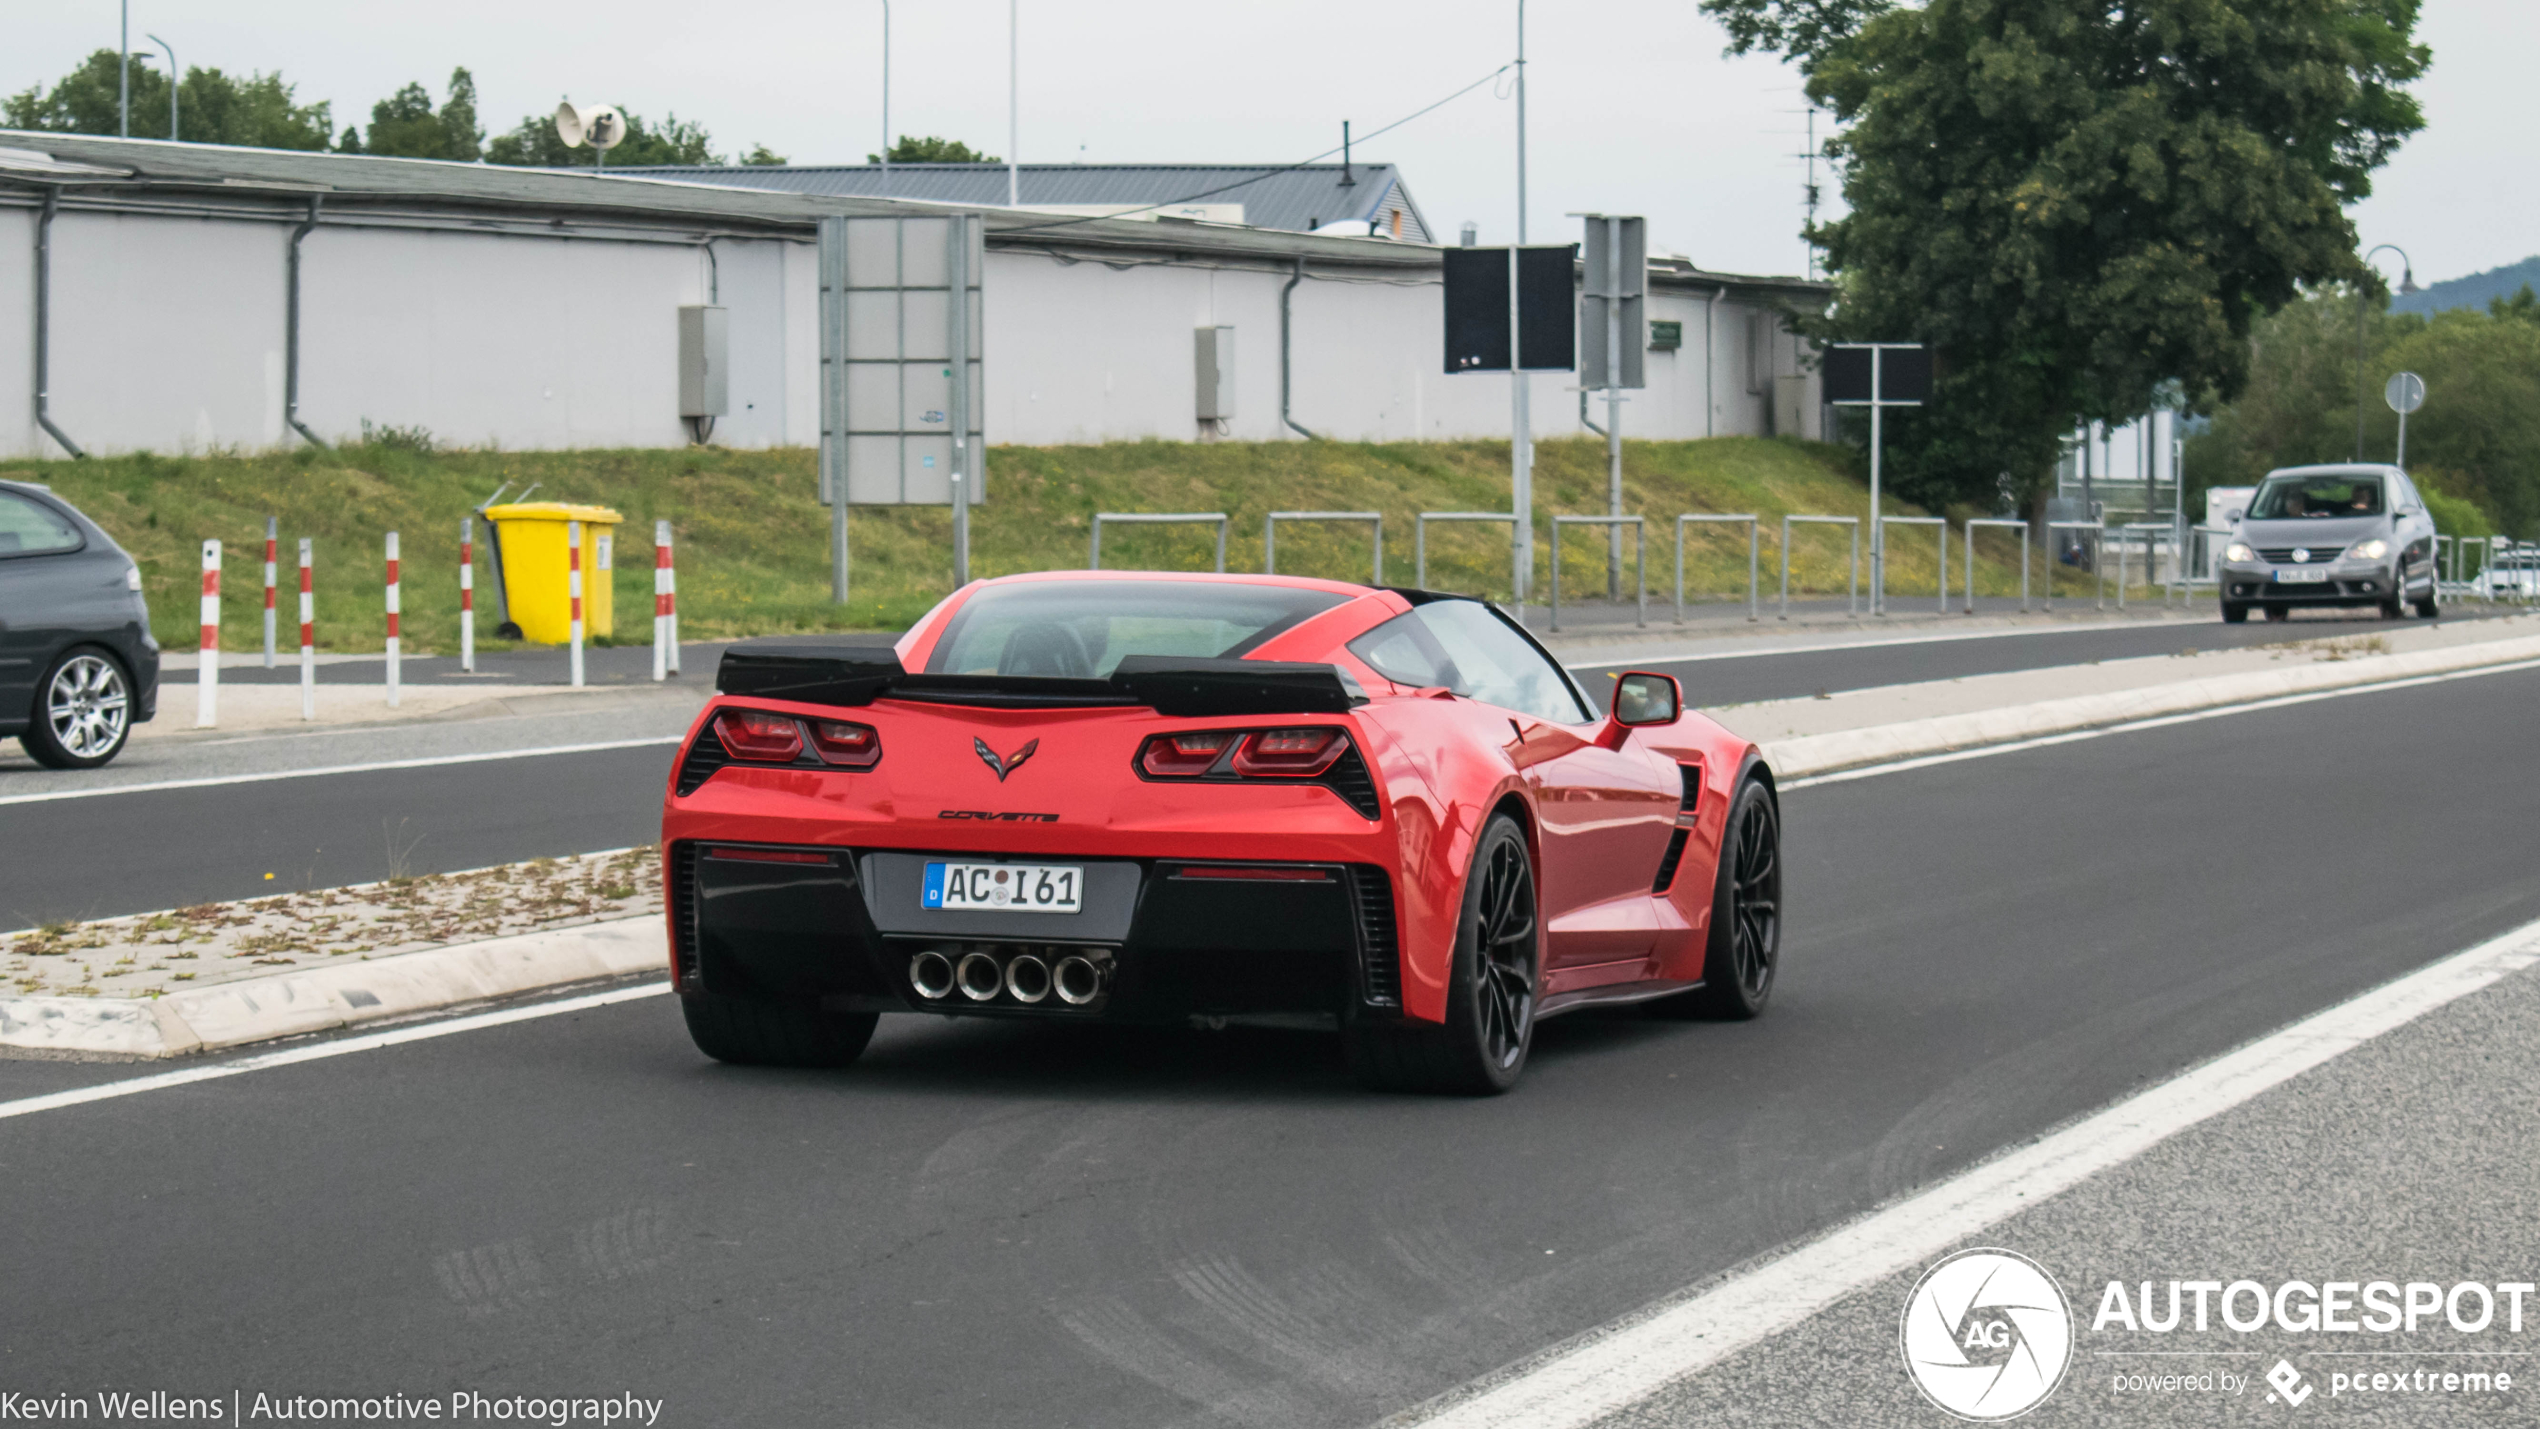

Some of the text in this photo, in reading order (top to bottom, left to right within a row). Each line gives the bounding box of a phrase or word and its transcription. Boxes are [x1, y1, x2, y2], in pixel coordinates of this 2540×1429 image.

[938, 810, 1060, 822] CORVETTE
[946, 868, 991, 902] AC
[929, 889, 938, 900] D
